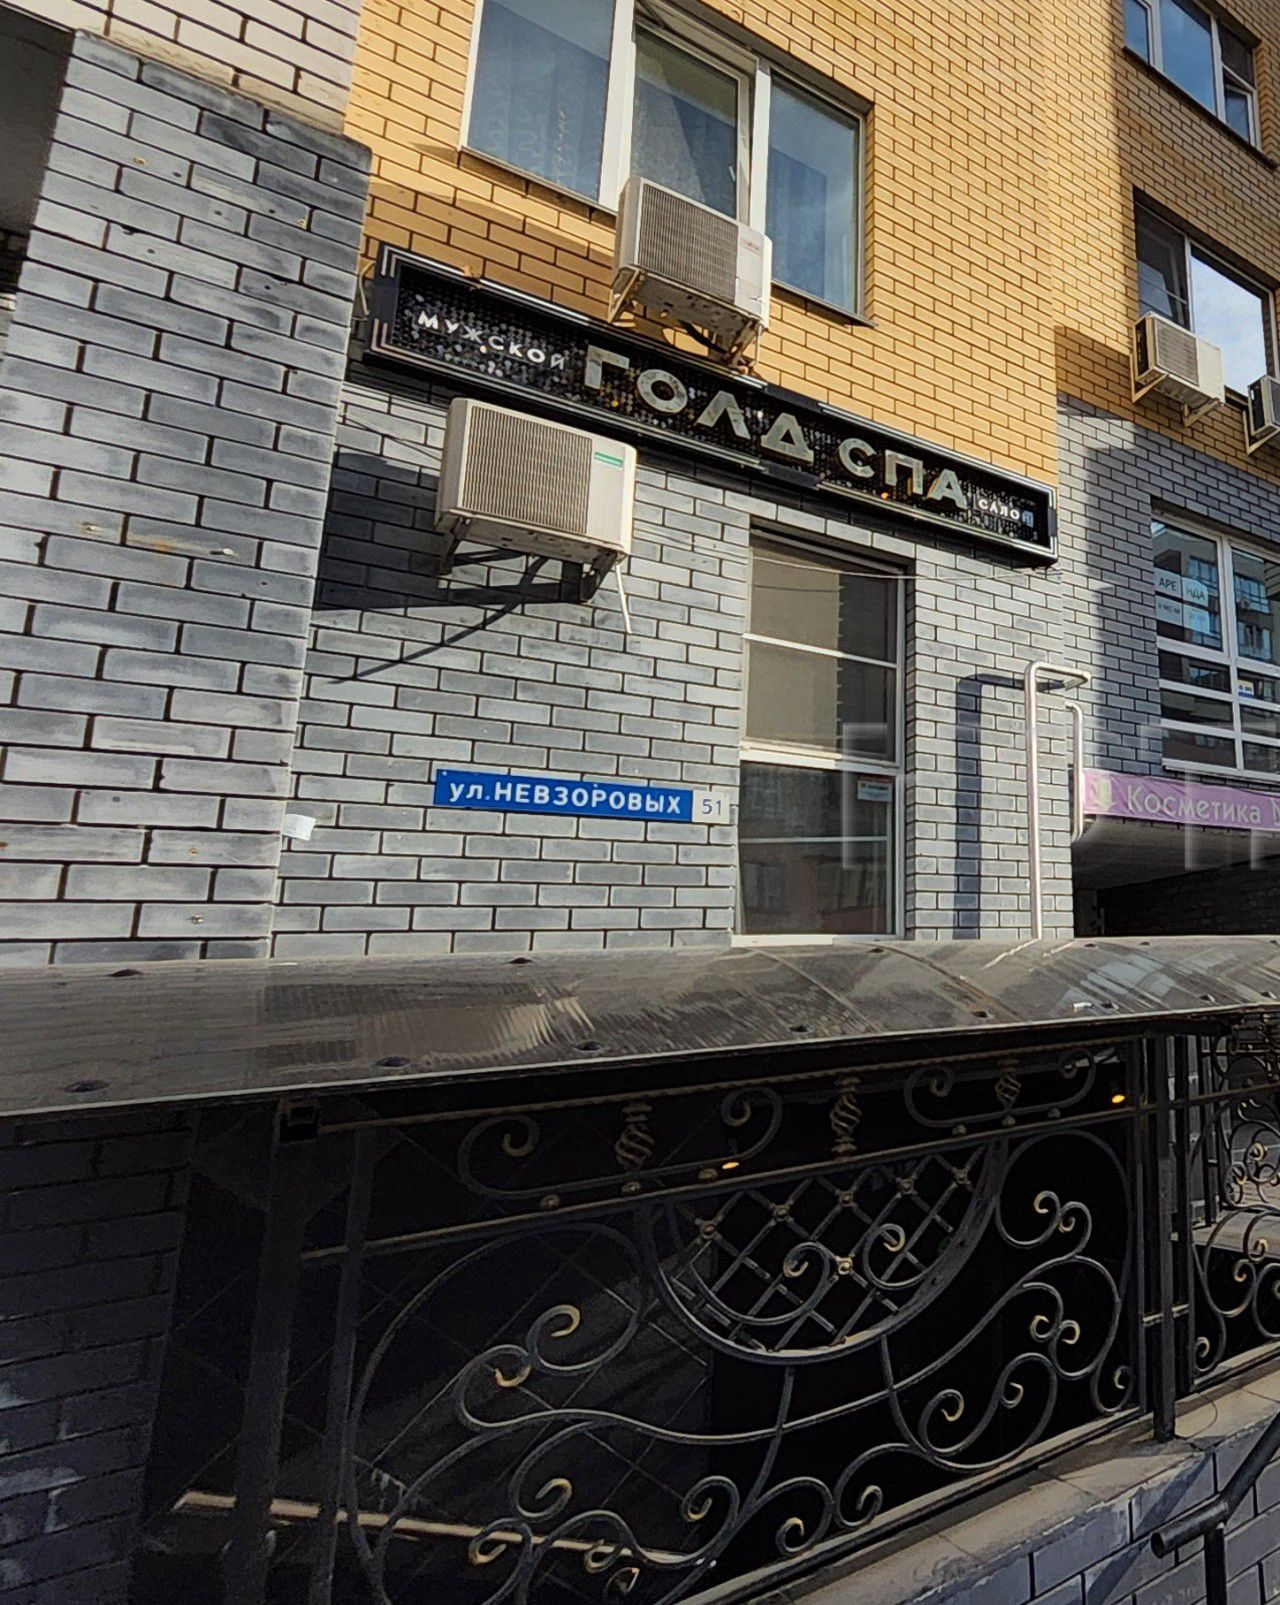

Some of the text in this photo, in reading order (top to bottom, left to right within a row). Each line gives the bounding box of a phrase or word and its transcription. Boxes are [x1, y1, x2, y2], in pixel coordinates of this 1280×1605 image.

[417, 311, 566, 371] МУЖСКОЙ
[585, 346, 815, 462] ГОЛД
[838, 438, 967, 509] СПА
[701, 798, 722, 816] 51
[1127, 784, 1262, 825] Косметика
